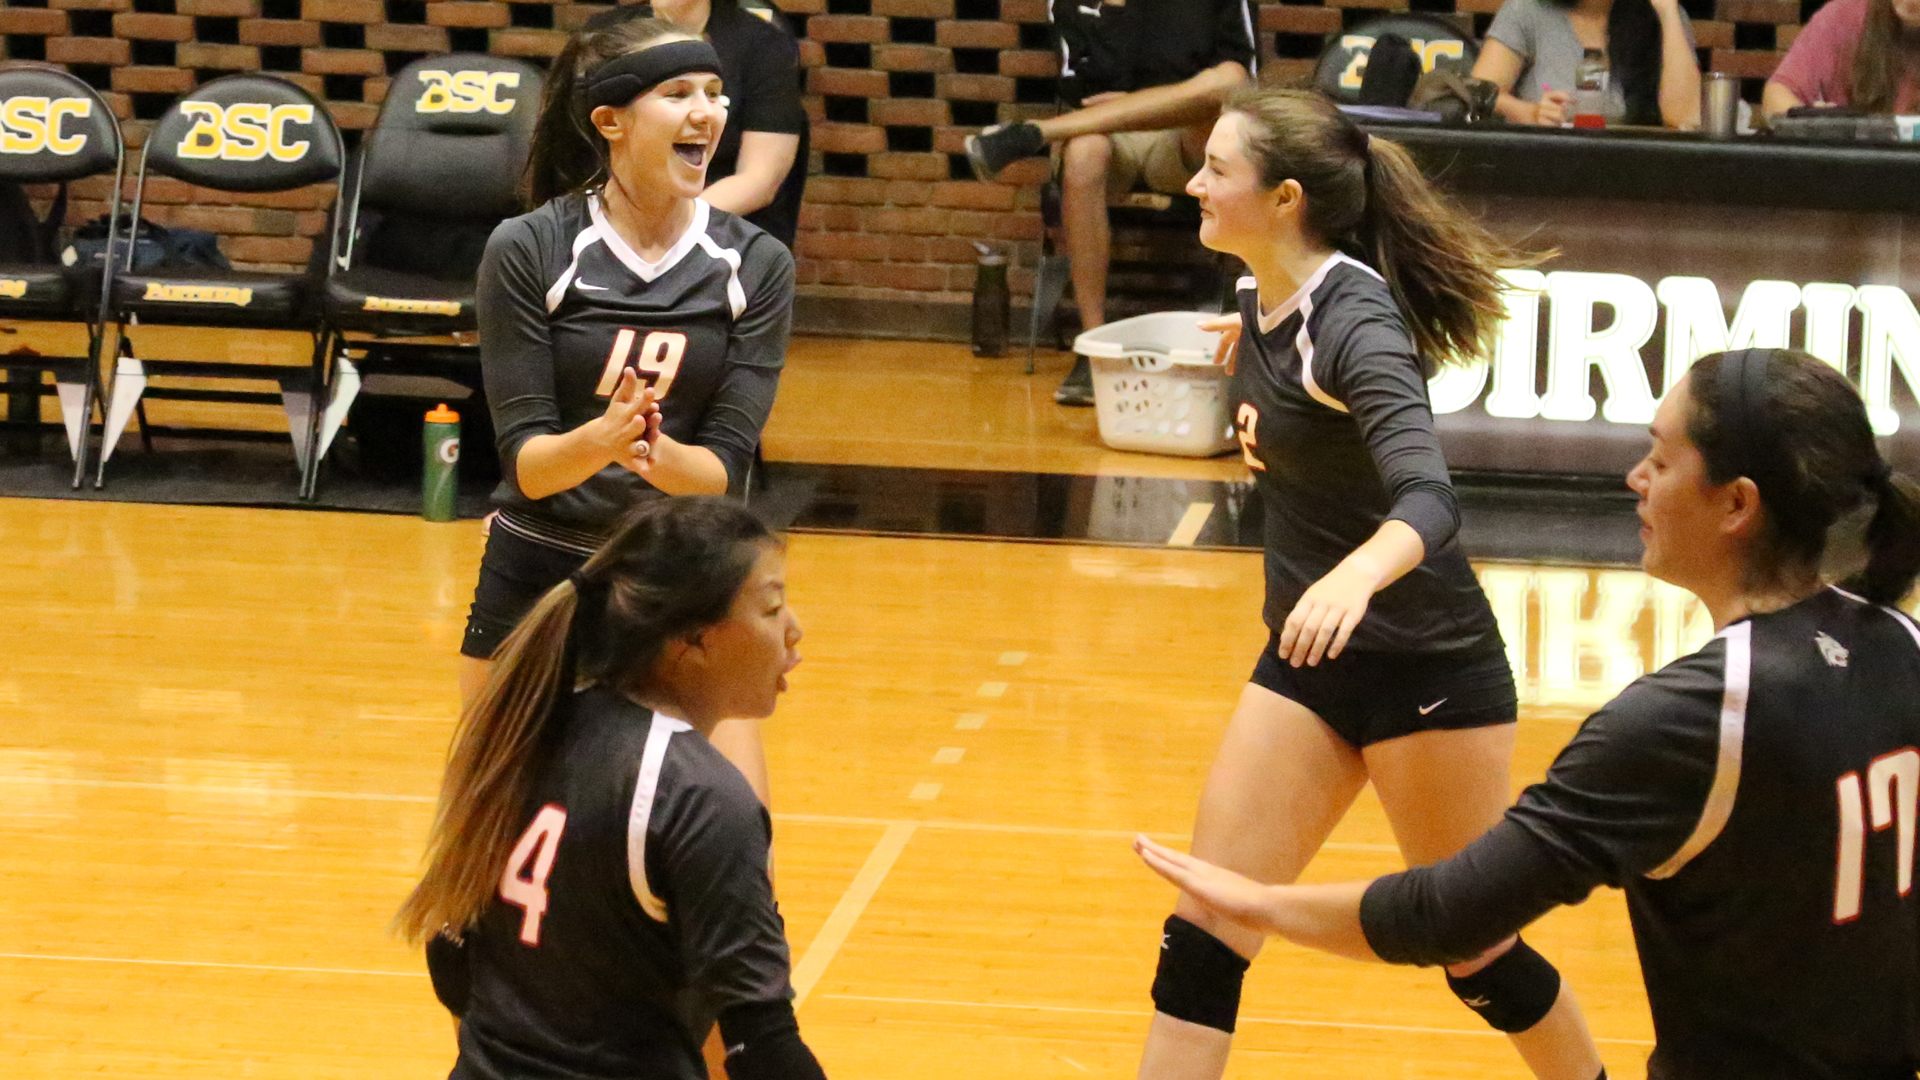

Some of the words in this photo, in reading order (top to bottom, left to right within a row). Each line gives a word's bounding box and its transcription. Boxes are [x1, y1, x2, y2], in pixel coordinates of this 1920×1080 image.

[0, 95, 92, 156] SC
[416, 70, 520, 115] BSC
[177, 101, 314, 162] BSC
[594, 327, 689, 400] 19
[1236, 401, 1267, 472] 2
[1832, 746, 1920, 926] 17
[500, 802, 568, 948] 4
